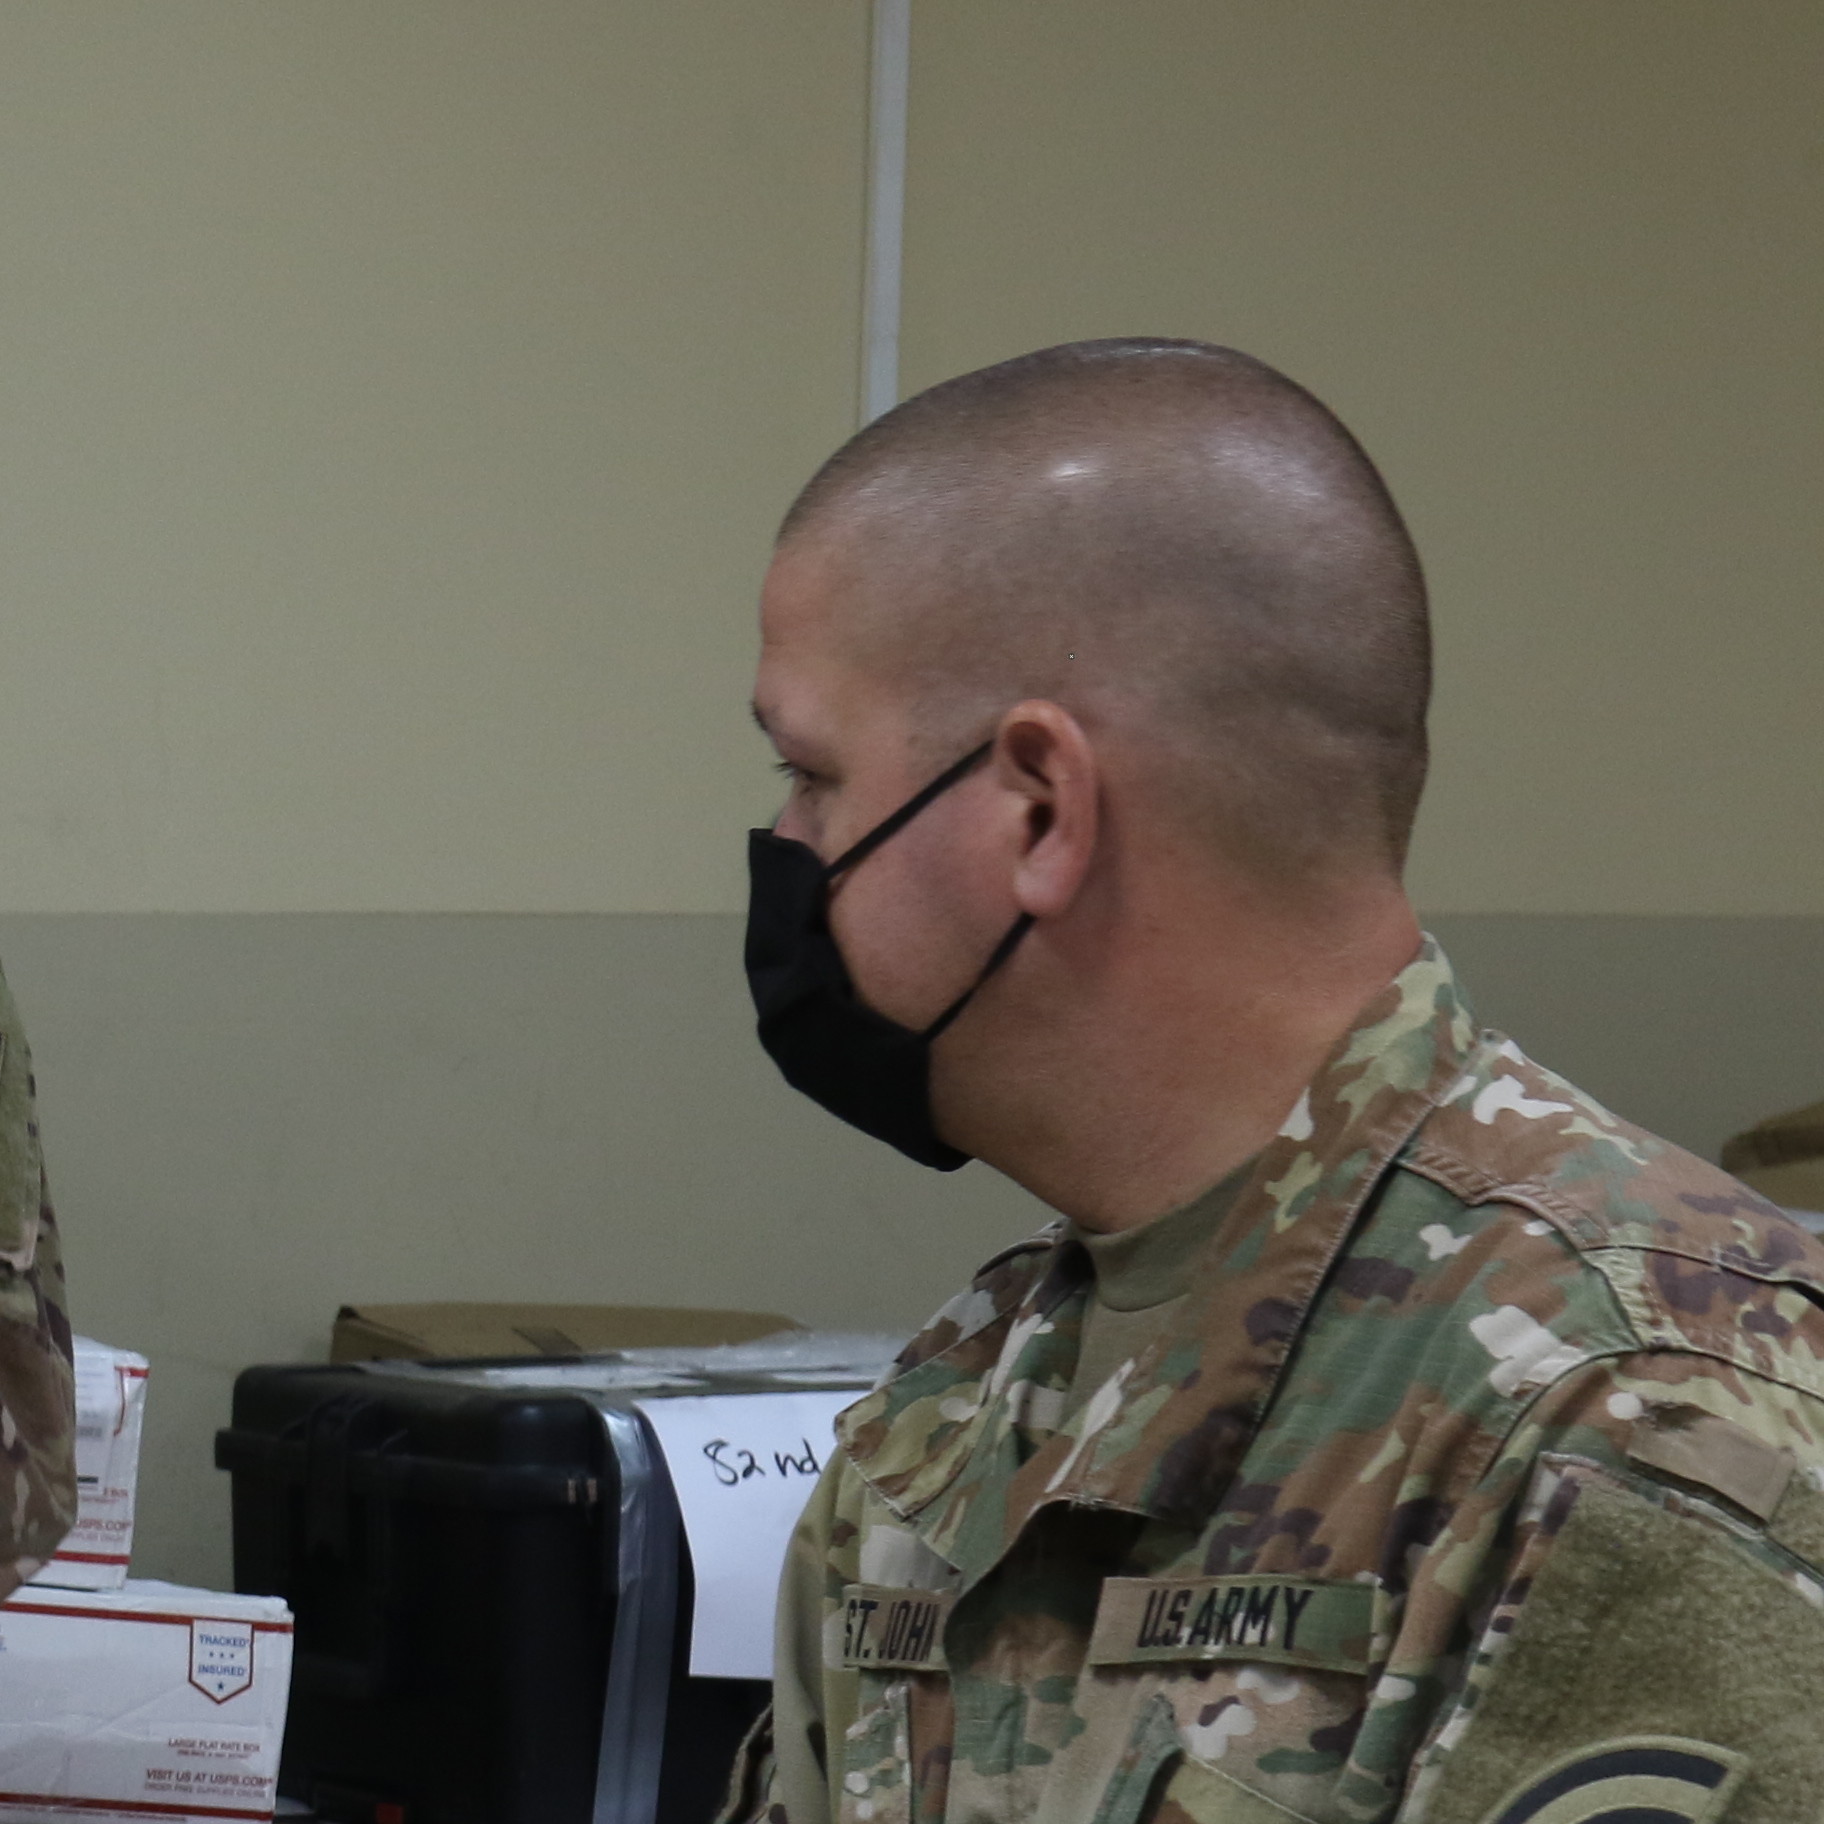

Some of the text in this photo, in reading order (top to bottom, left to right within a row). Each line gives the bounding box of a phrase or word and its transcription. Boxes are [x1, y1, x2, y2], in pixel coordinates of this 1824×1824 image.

[1190, 1585, 1316, 1651] ARMY
[199, 1634, 246, 1648] TRACKED
[197, 1664, 245, 1677] INSURED
[199, 1740, 219, 1750] FLAT
[146, 1768, 173, 1780] VISIT
[176, 1770, 191, 1782] US
[194, 1772, 207, 1782] AT
